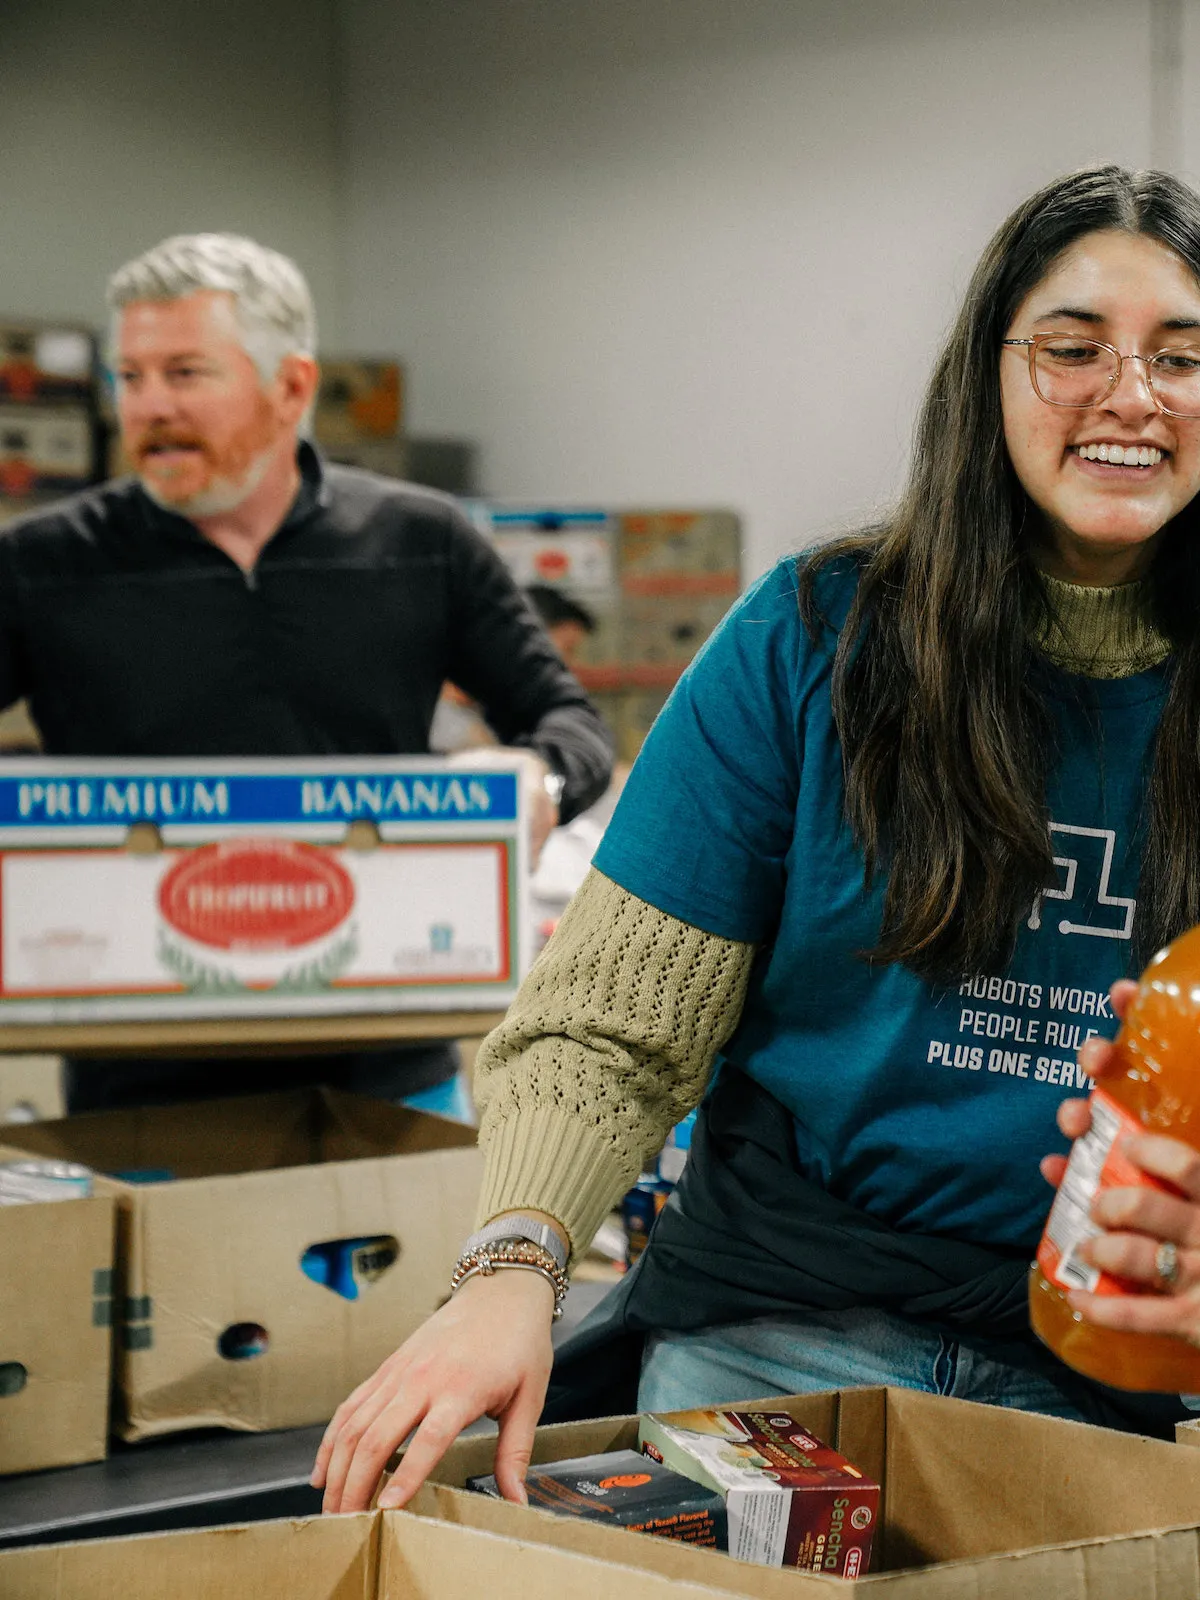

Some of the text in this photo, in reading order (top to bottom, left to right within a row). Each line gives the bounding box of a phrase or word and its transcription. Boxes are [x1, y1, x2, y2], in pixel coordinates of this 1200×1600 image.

[18, 778, 490, 817] PREMIUM BANANAS
[959, 973, 1114, 1019] ROBOTS WORK.
[959, 1008, 1040, 1043] PEOPLE
[926, 1040, 983, 1072] PLUS
[988, 1049, 1032, 1079] ONE
[645, 1520, 653, 1529] of
[679, 1509, 709, 1522] Flavored
[824, 1498, 850, 1569] Sencha
[812, 1534, 826, 1573] GREE
[846, 1552, 859, 1579] H-E-
